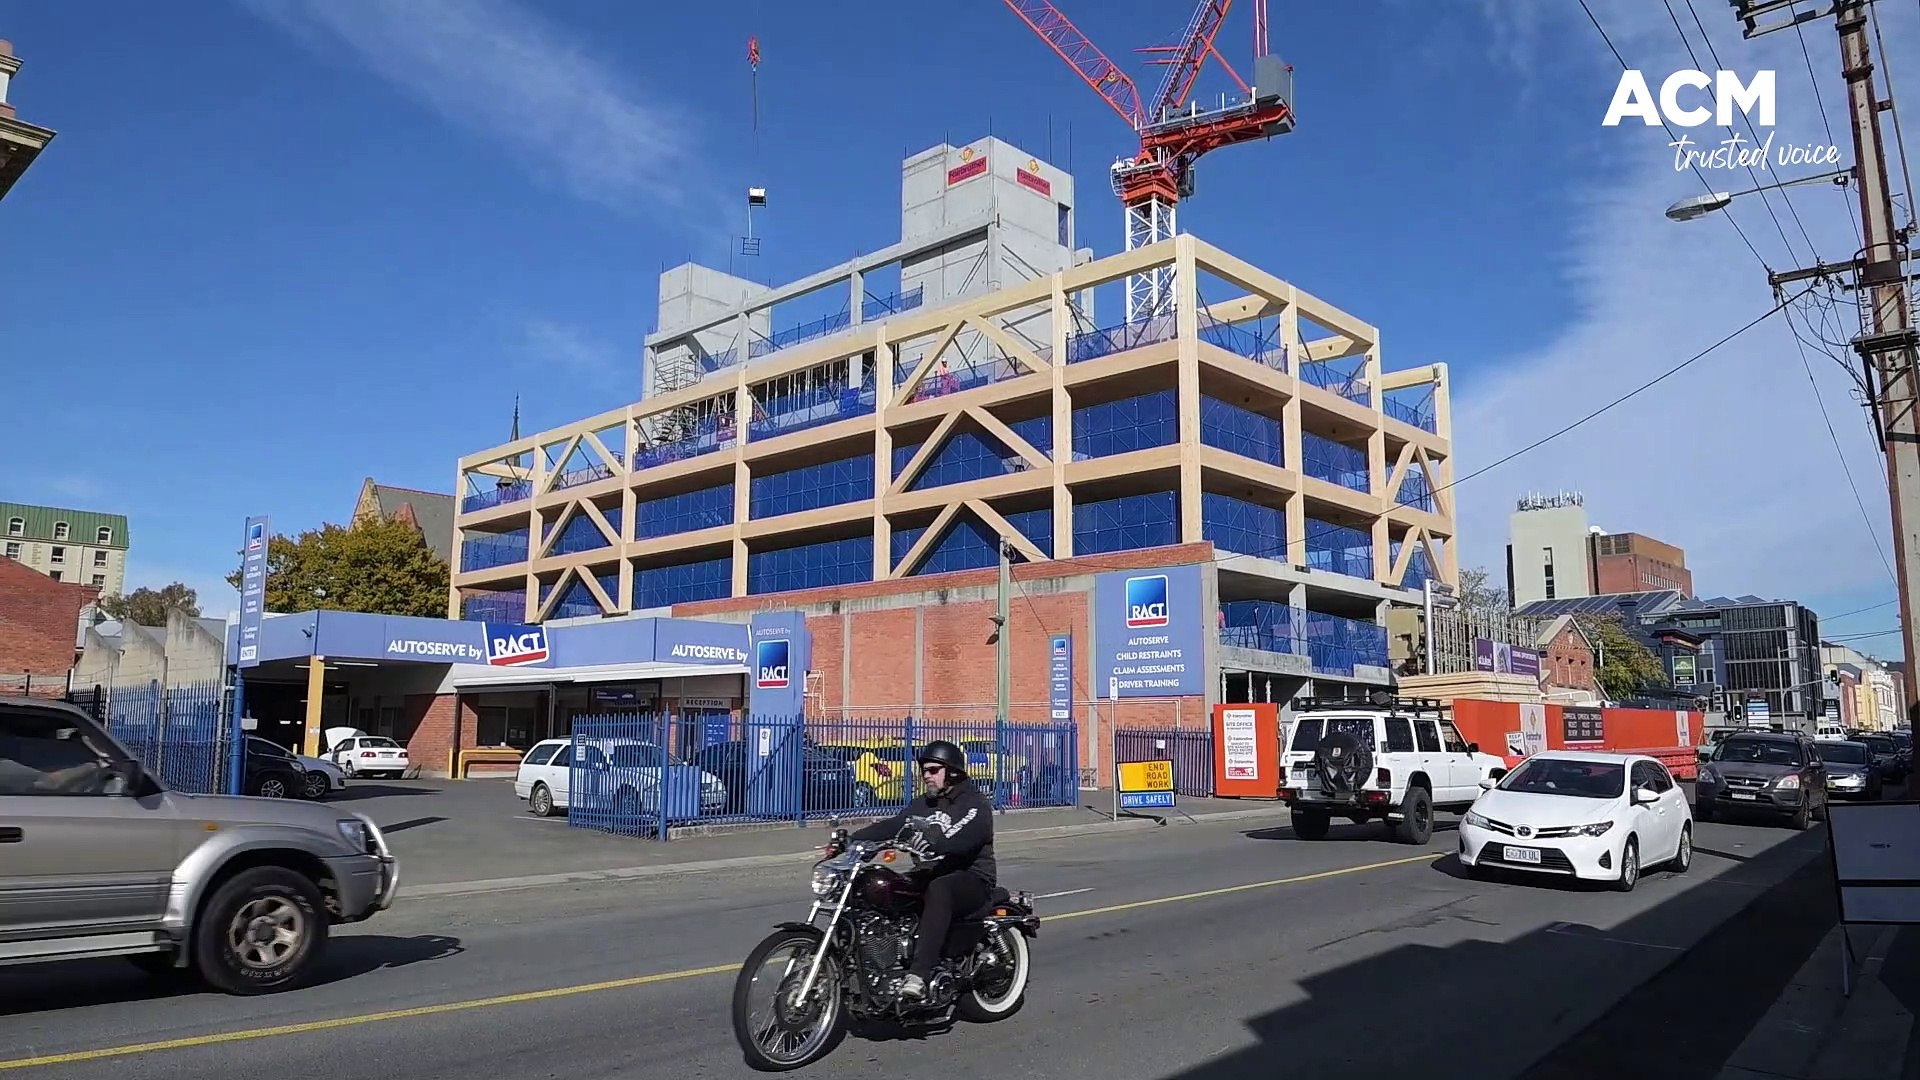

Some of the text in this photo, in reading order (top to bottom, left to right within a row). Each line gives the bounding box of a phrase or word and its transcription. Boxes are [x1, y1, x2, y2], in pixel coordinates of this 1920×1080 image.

[1132, 602, 1165, 619] RACT
[755, 627, 785, 636] AUTOSERVE
[387, 632, 541, 660] AUTOSERVE by RACT
[1128, 635, 1169, 646] AUTOSERVE
[671, 644, 749, 663] AUTOSERVE by
[1116, 649, 1182, 661] CHILD RESTRAINTS
[761, 664, 787, 680] RACT
[1113, 664, 1185, 675] CLAIM ASSESSMENTS
[1119, 678, 1180, 689] DRIVER TRAINING
[1148, 763, 1165, 771] END
[1146, 771, 1168, 780] ROAD
[1147, 780, 1169, 788] WORK
[1123, 794, 1171, 805] DRIVE SAFELY
